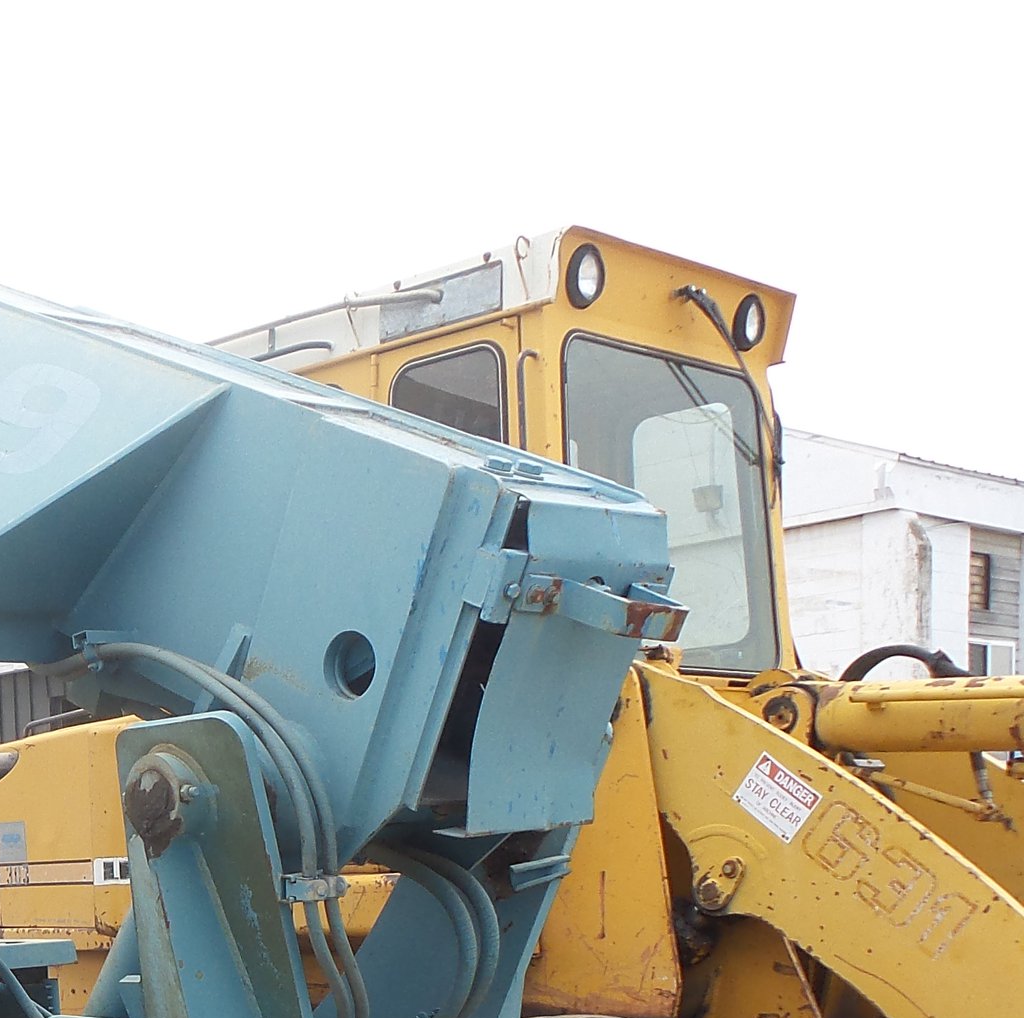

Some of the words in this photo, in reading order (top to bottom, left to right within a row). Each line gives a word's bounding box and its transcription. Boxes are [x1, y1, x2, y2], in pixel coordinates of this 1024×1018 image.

[745, 778, 769, 801] STAY
[769, 797, 802, 828] CLEAR
[773, 770, 815, 808] DANGER
